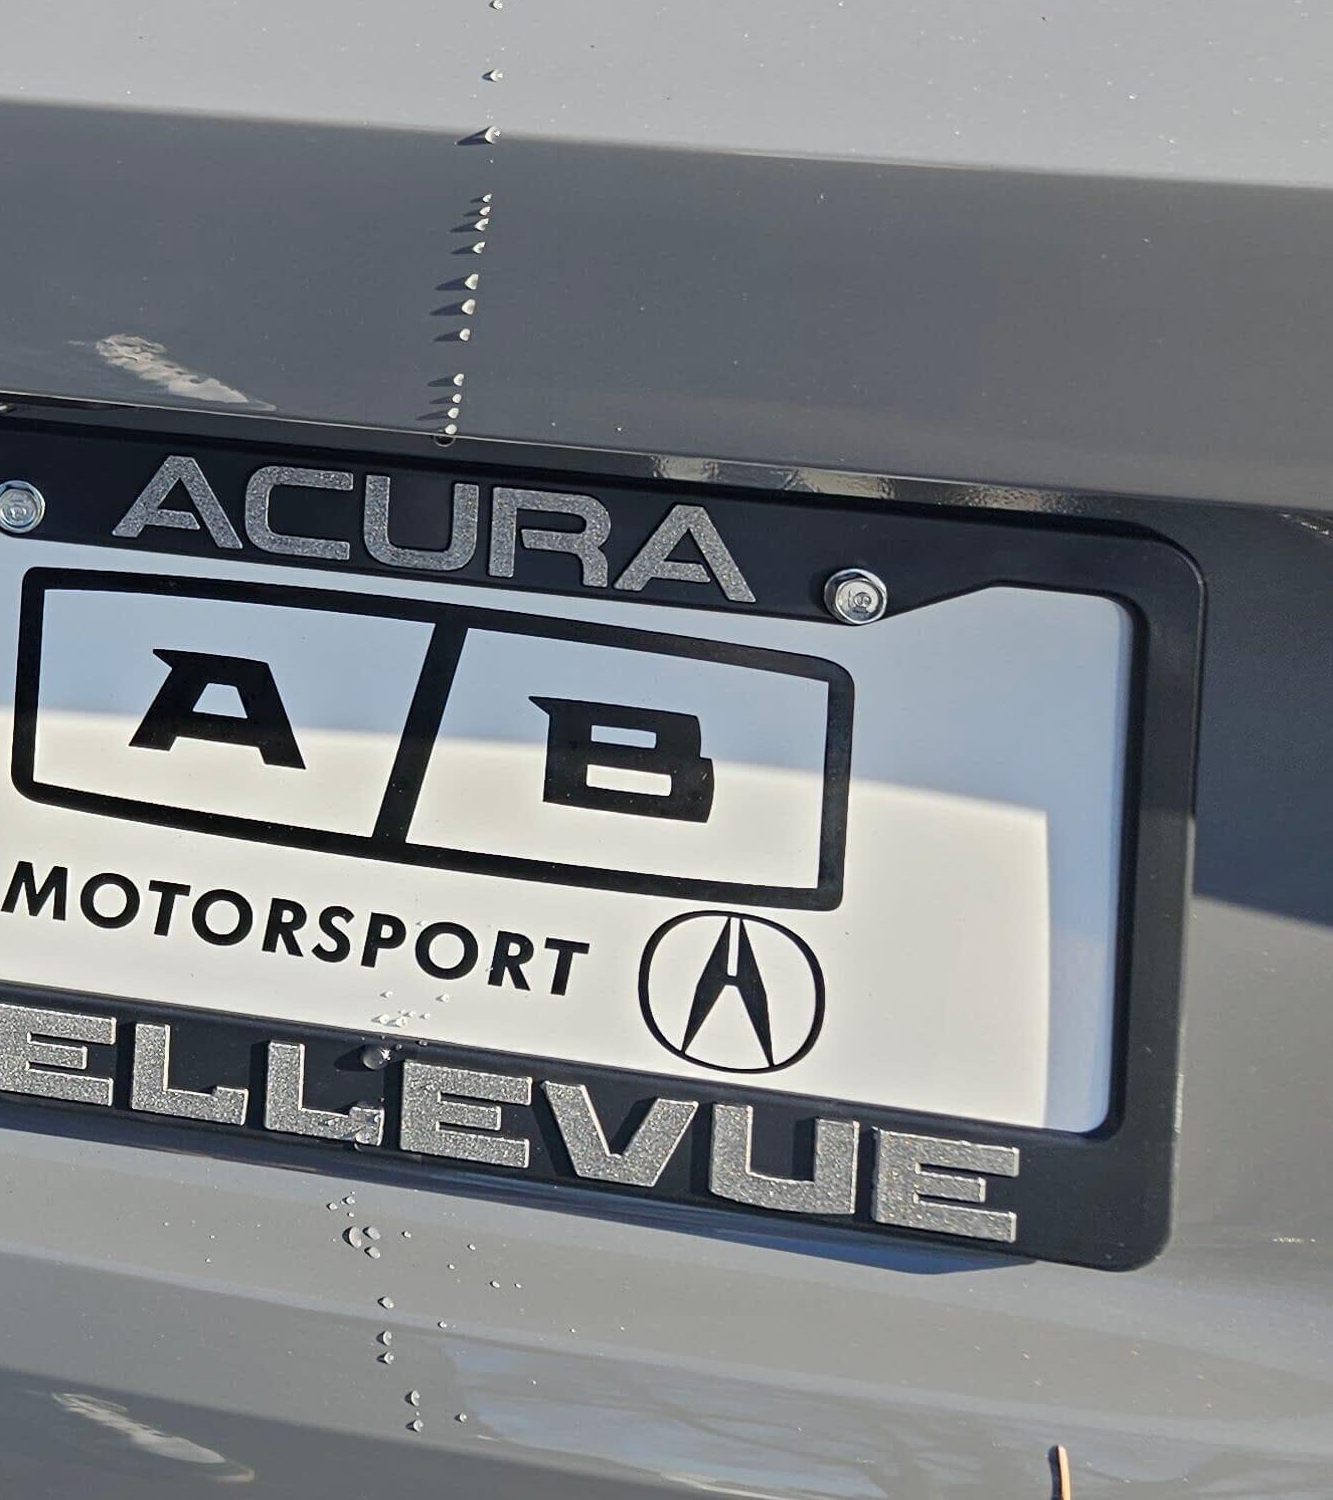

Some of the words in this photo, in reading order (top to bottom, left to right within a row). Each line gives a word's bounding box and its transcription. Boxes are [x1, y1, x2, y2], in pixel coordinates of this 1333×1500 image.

[111, 455, 756, 604] ACURA
[130, 648, 307, 770] A
[528, 695, 715, 823] B
[1, 860, 590, 997] MOTORSPORT
